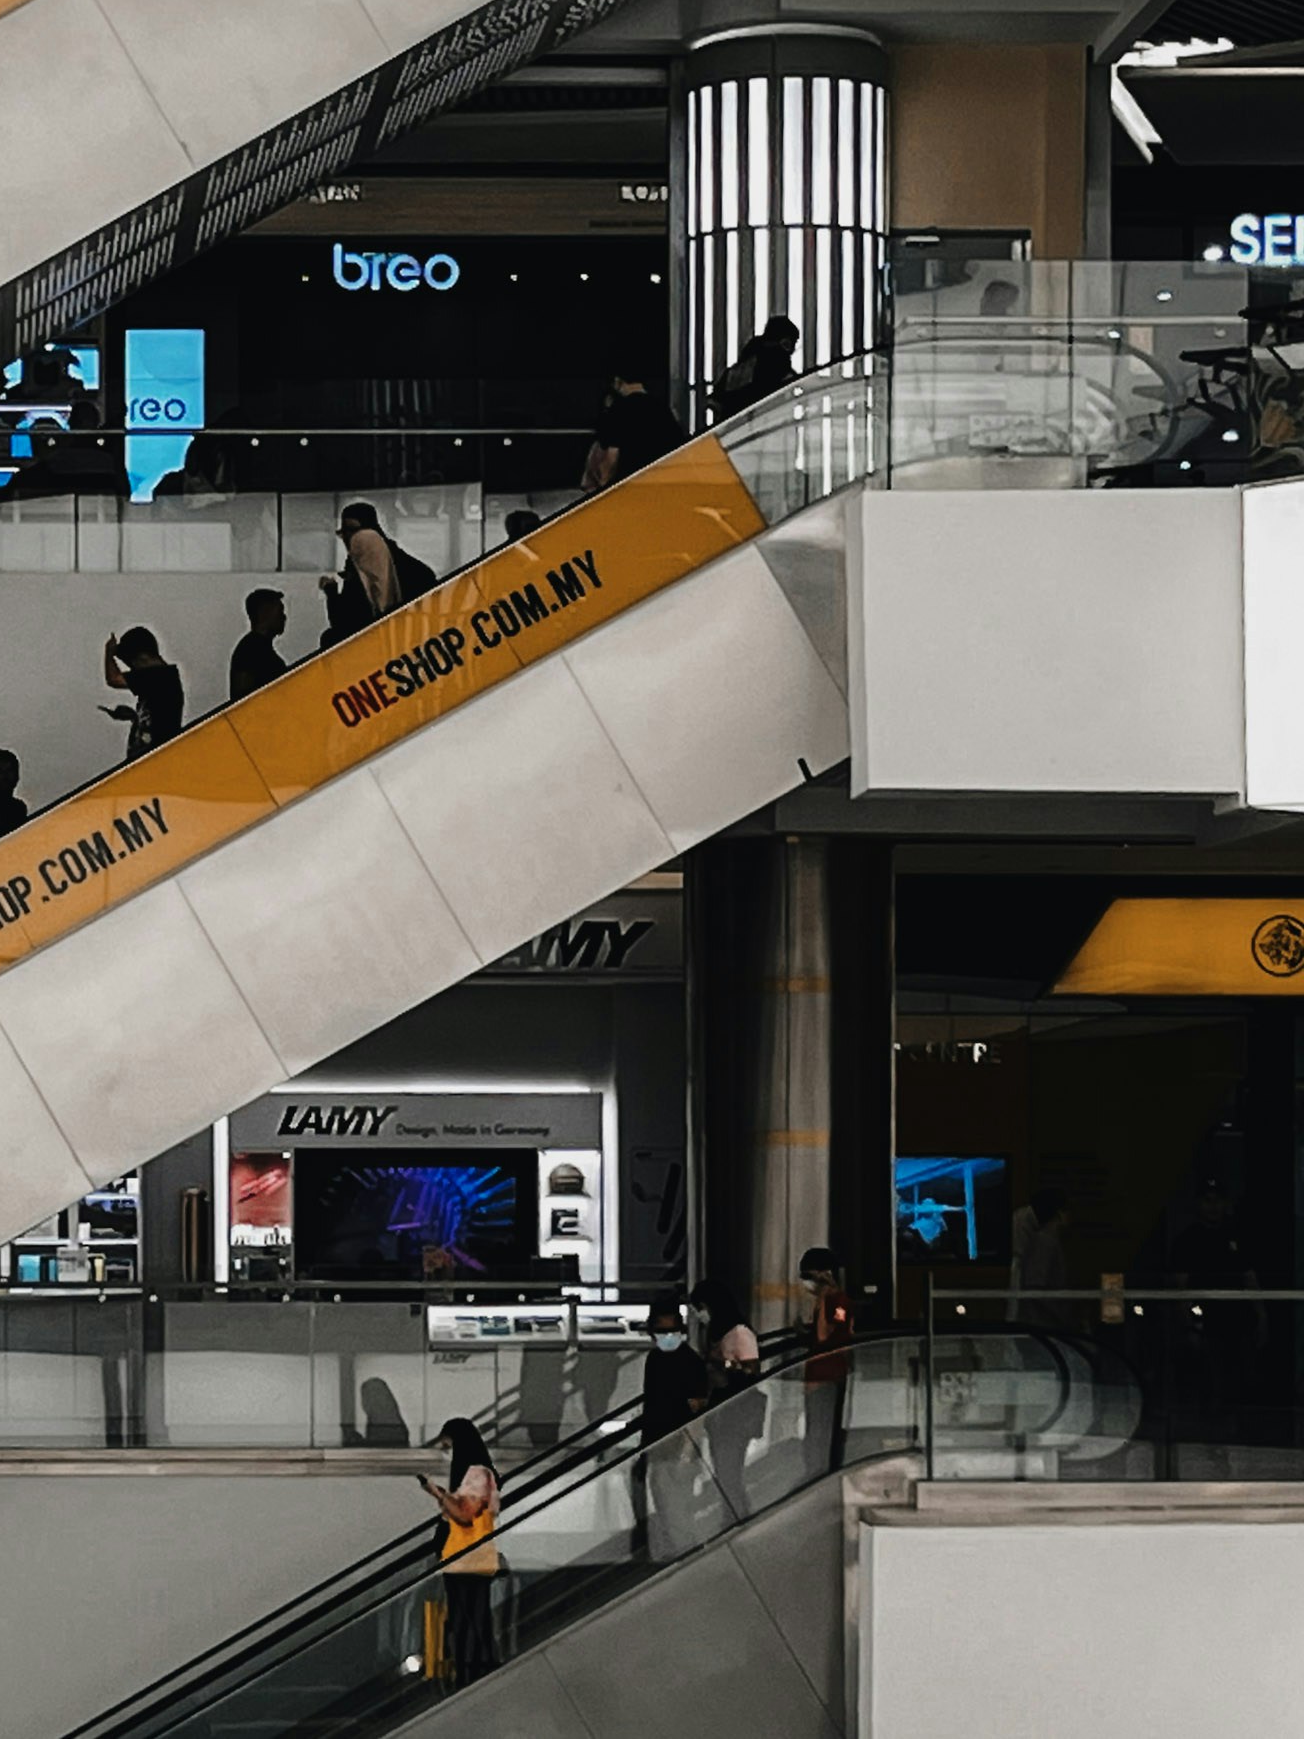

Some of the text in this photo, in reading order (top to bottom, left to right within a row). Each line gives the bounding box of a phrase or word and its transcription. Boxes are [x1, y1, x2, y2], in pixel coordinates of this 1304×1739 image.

[1230, 212, 1304, 266] SE
[332, 241, 461, 292] breo
[331, 549, 603, 728] ONESHOP.COM.MY
[277, 1106, 399, 1136] LAMY
